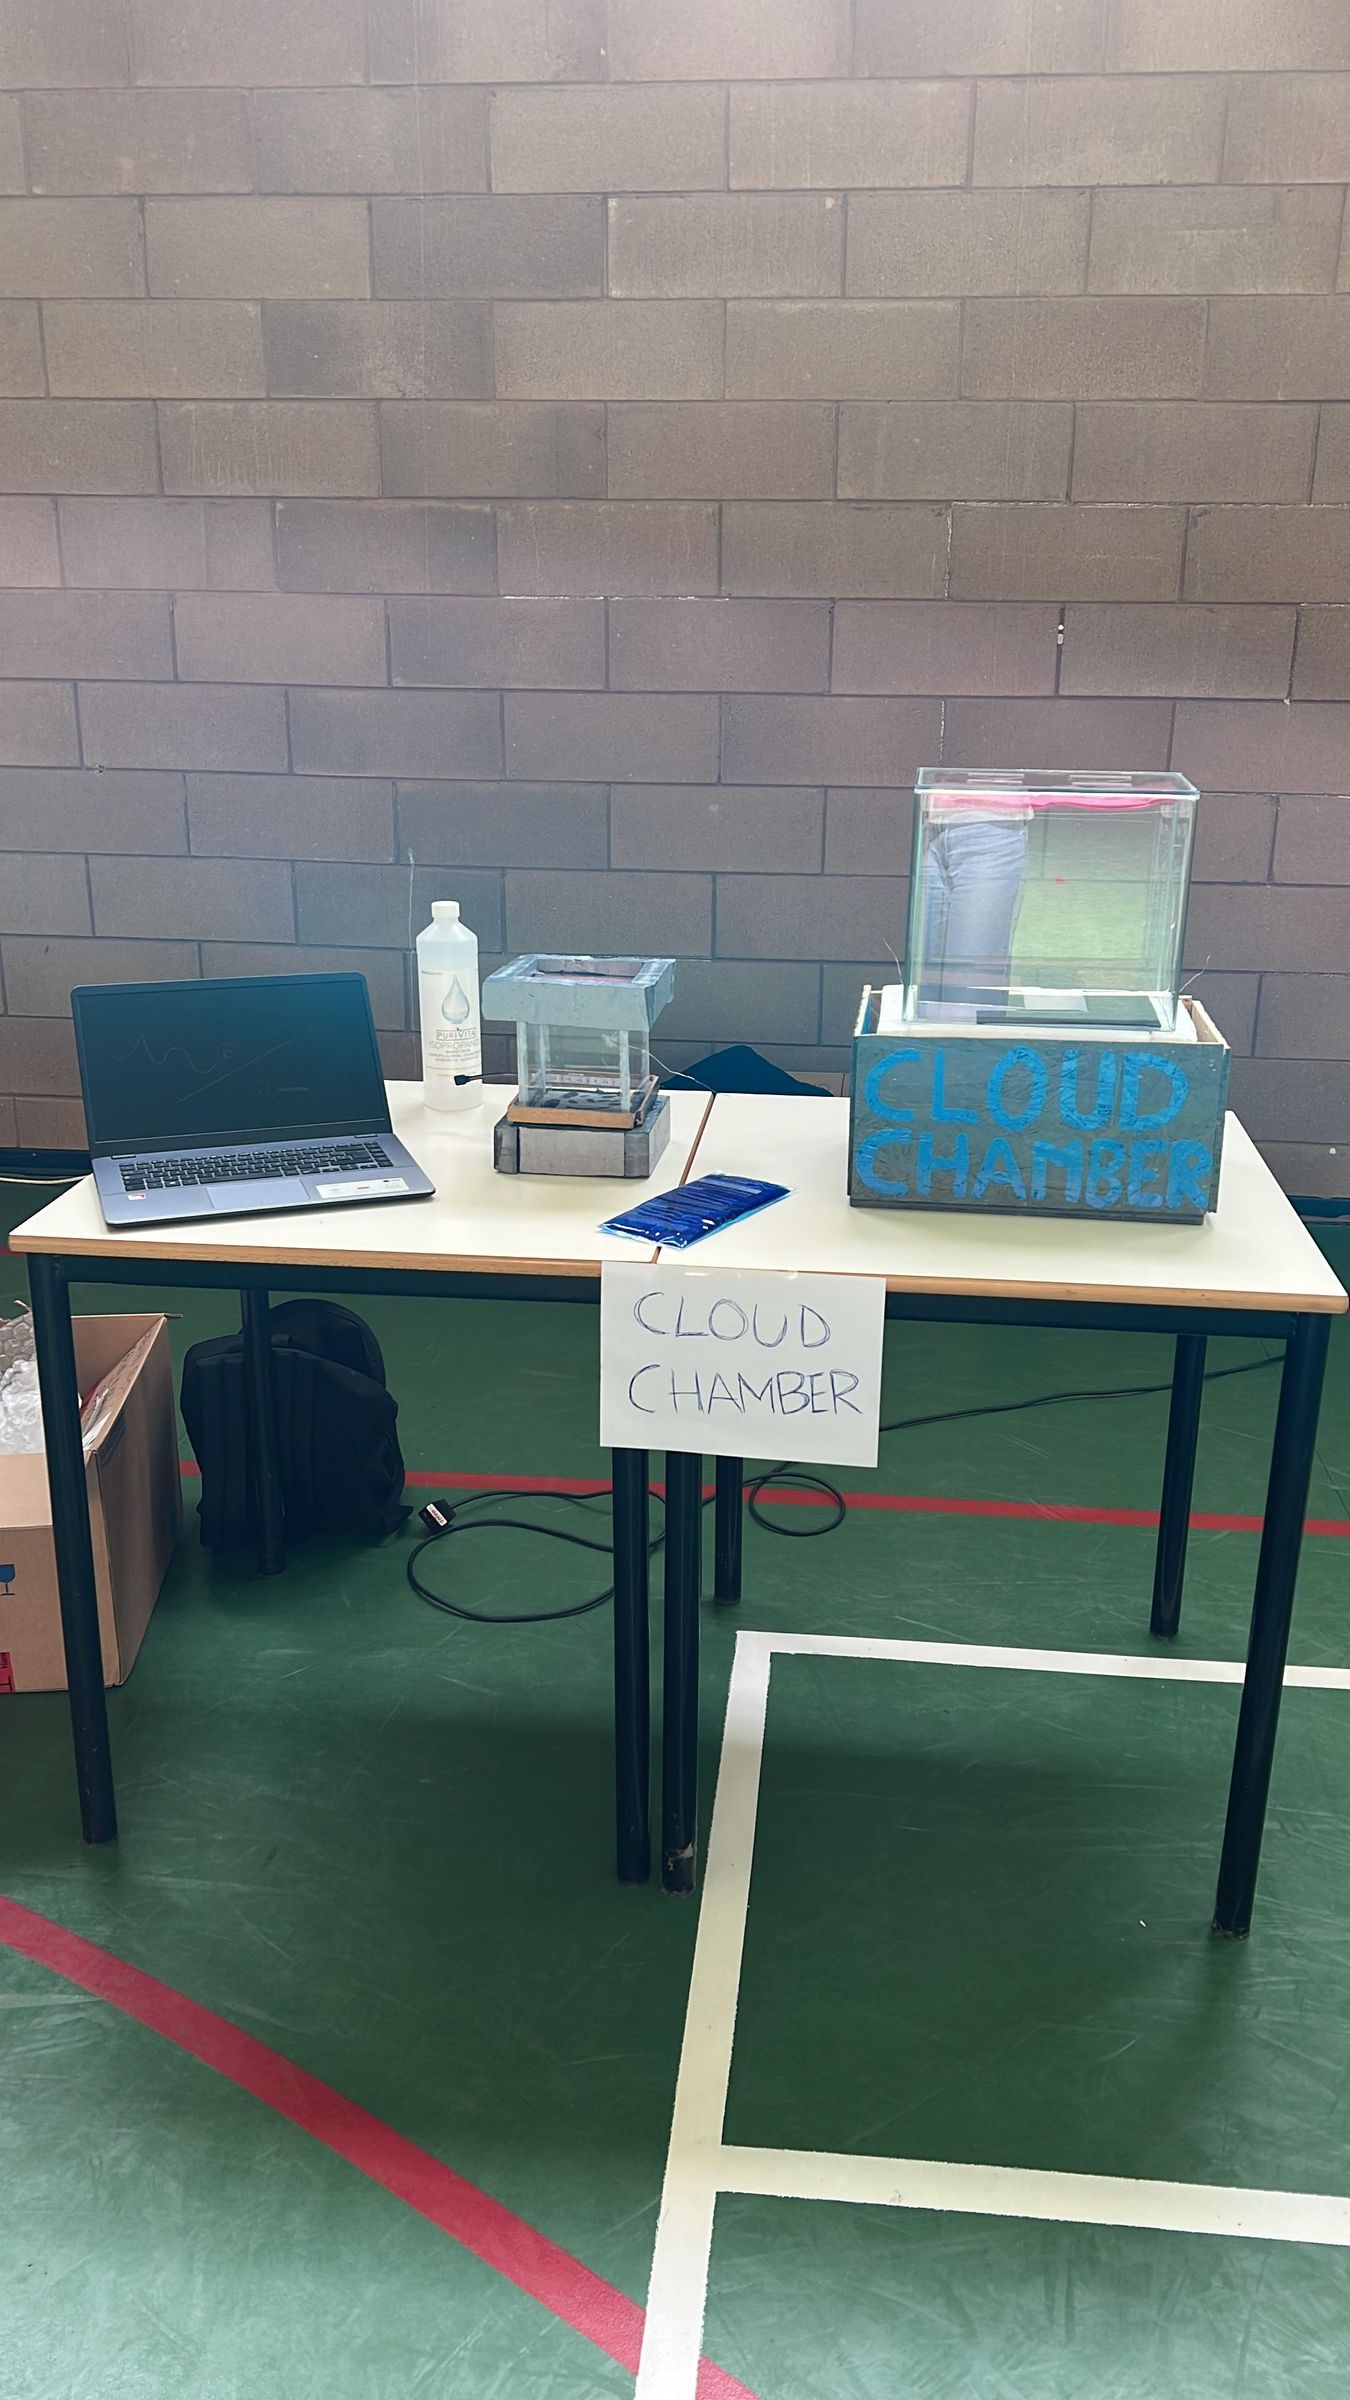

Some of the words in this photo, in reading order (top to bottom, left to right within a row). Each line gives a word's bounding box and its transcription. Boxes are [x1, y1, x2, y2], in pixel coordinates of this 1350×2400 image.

[436, 1029, 476, 1040] PURIVITA
[865, 1046, 1189, 1131] CLOUD
[855, 1129, 1212, 1210] CHAMBER
[634, 1292, 831, 1348] CLOUD
[629, 1364, 862, 1415] CHAMBER
